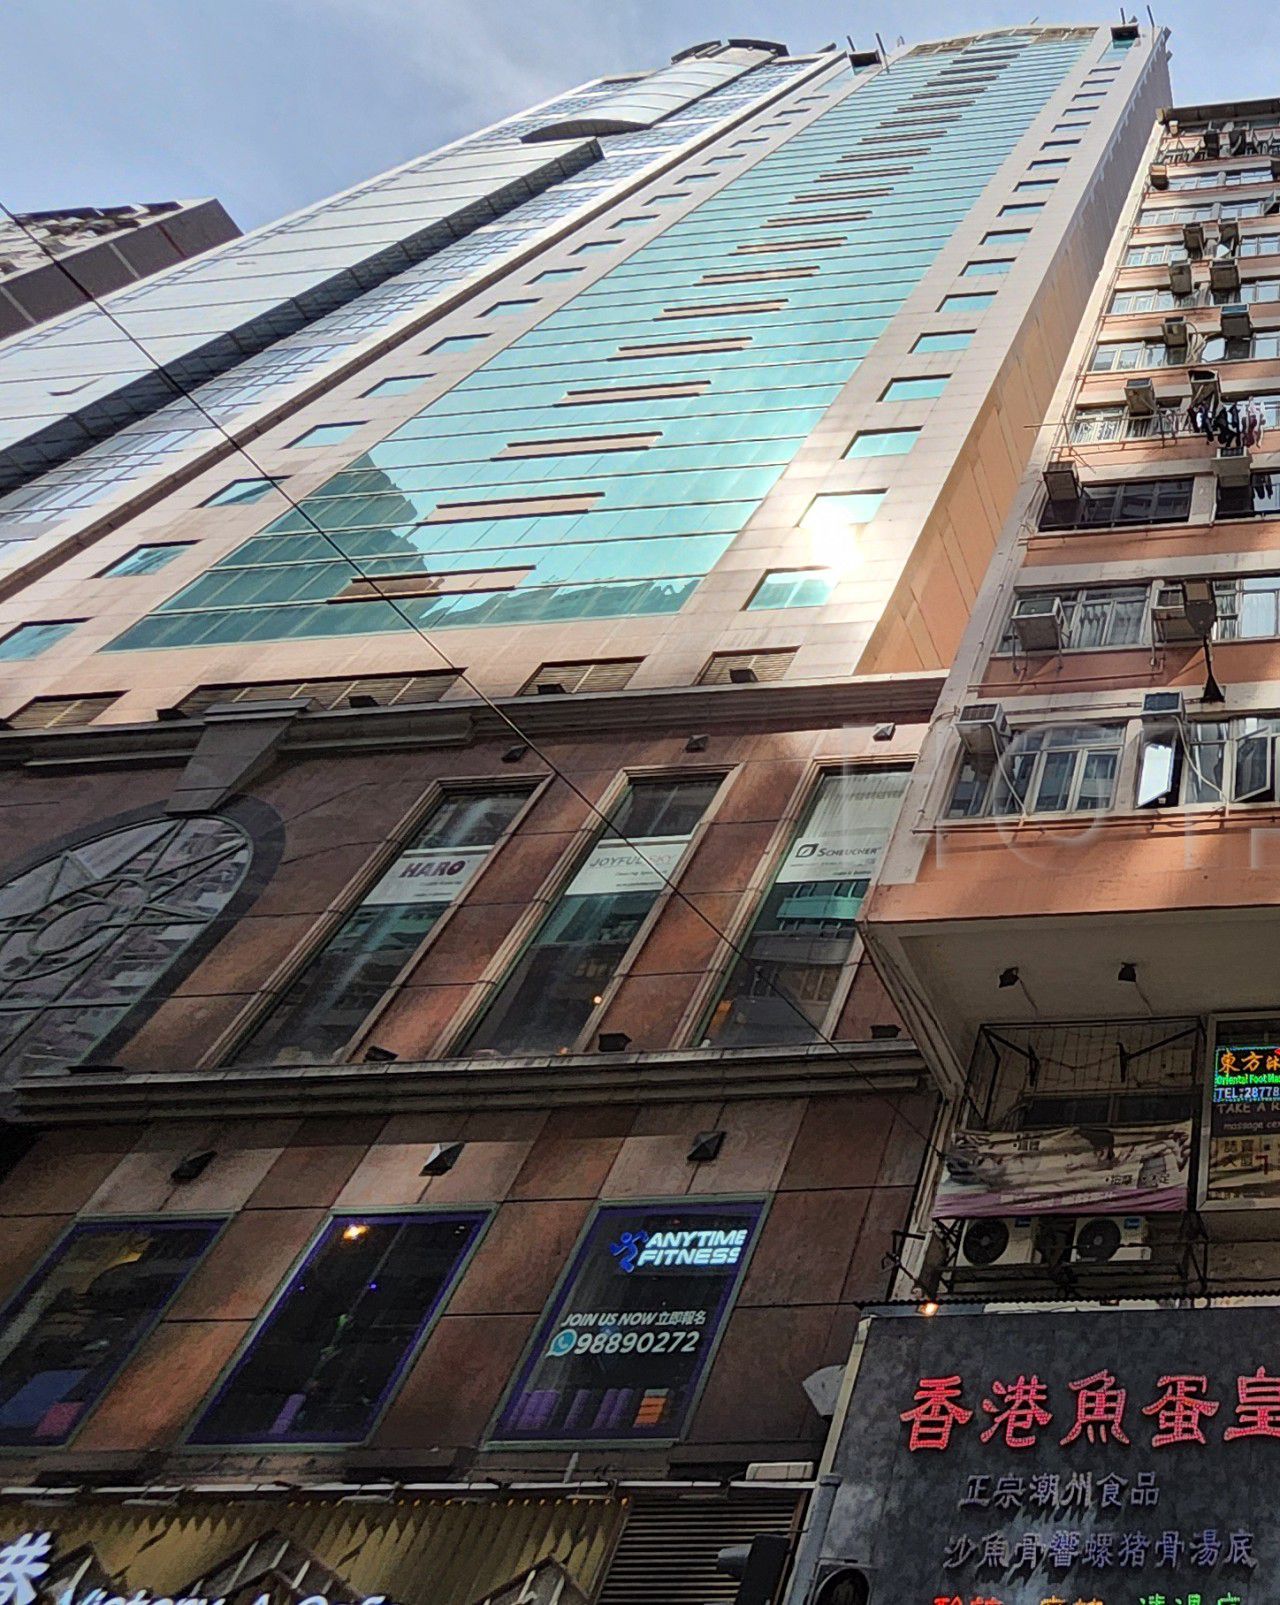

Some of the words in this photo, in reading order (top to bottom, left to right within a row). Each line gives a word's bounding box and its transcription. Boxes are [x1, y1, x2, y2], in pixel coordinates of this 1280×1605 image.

[399, 860, 467, 878] HARO
[1216, 1074, 1248, 1085] Oriental
[1250, 1074, 1267, 1084] Foot
[1217, 1103, 1251, 1114] TAKE
[1257, 1102, 1266, 1112] A
[1224, 1122, 1263, 1131] massage
[645, 1229, 748, 1249] ANYTIME
[637, 1247, 742, 1267] FITNESS
[561, 1312, 598, 1327] JOIN
[598, 1312, 616, 1326] US
[618, 1312, 657, 1326] NOW
[655, 1310, 707, 1325] 立即報名
[574, 1331, 700, 1355] 98890272
[958, 1471, 1160, 1510] 正宗潮州食品
